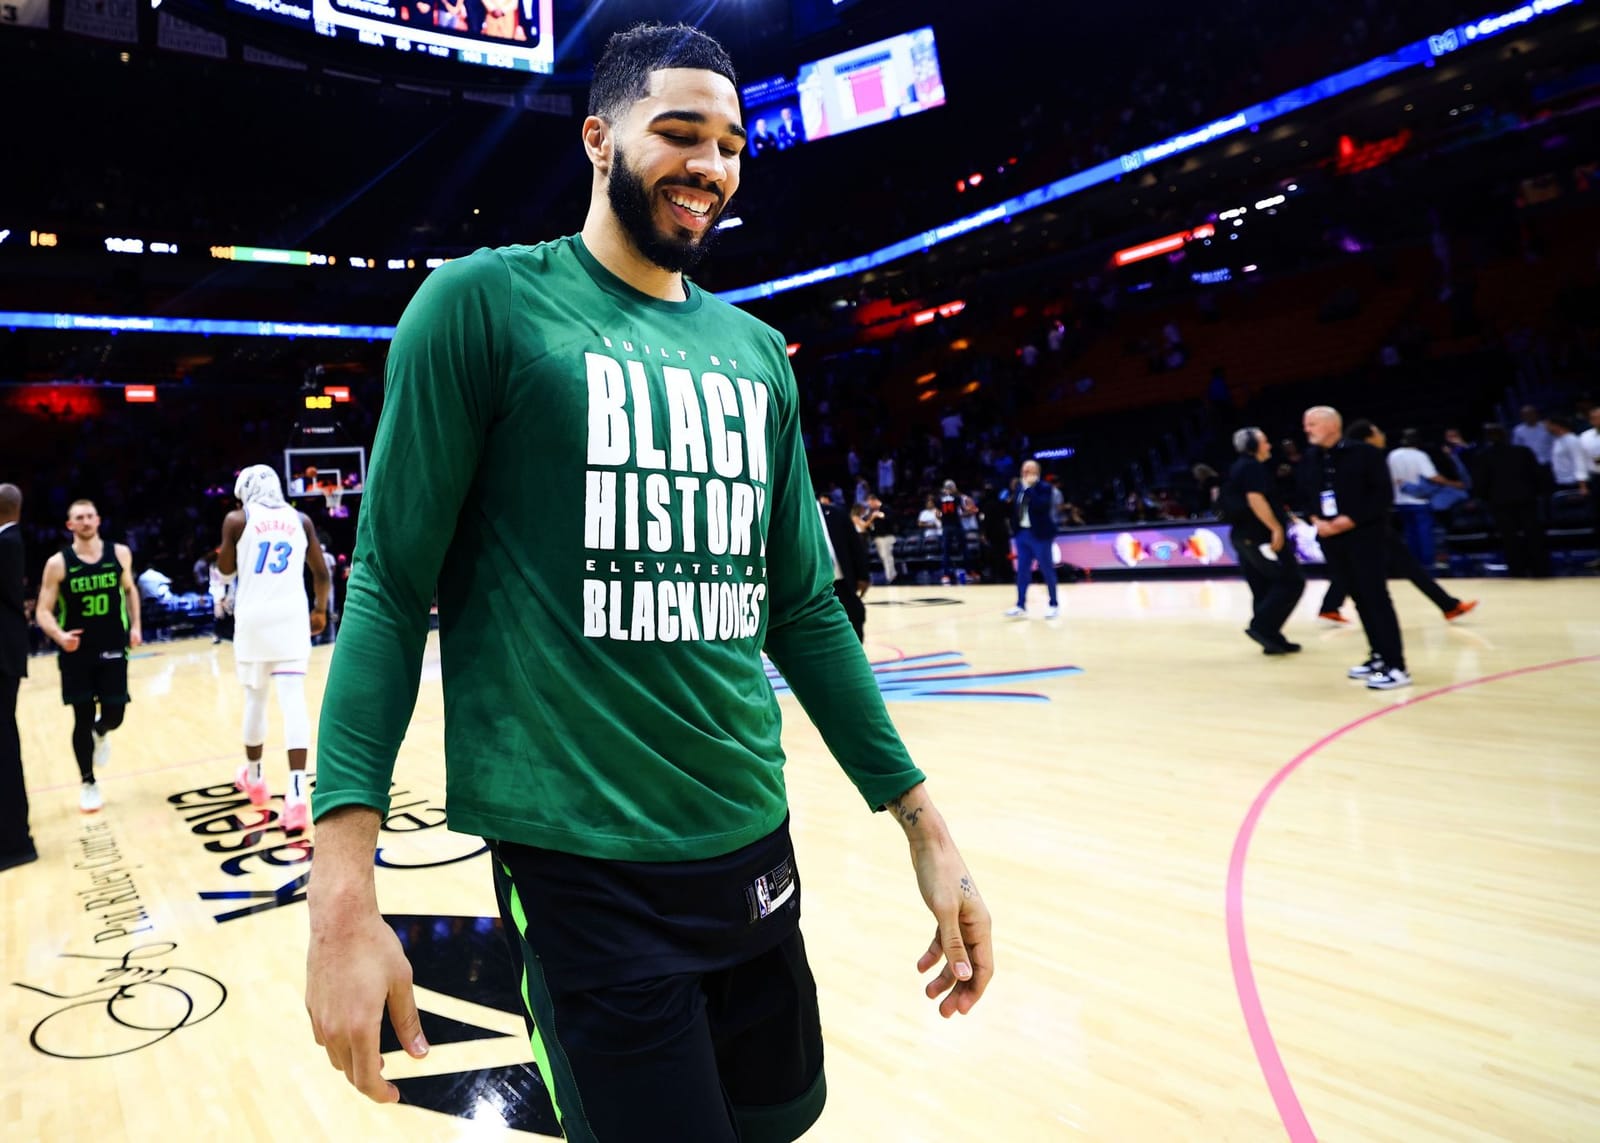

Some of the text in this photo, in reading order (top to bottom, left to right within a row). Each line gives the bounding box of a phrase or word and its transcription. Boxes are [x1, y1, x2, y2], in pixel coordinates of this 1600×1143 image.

[603, 336, 739, 370] BUILT BY
[584, 352, 768, 484] BLACK
[584, 470, 766, 557] HISTORY
[254, 541, 293, 574] 13
[585, 559, 733, 576] ELEVATED
[70, 572, 118, 593] CELTICS
[81, 593, 110, 617] 30
[583, 579, 700, 643] BLACK
[167, 782, 315, 925] Kaseya
